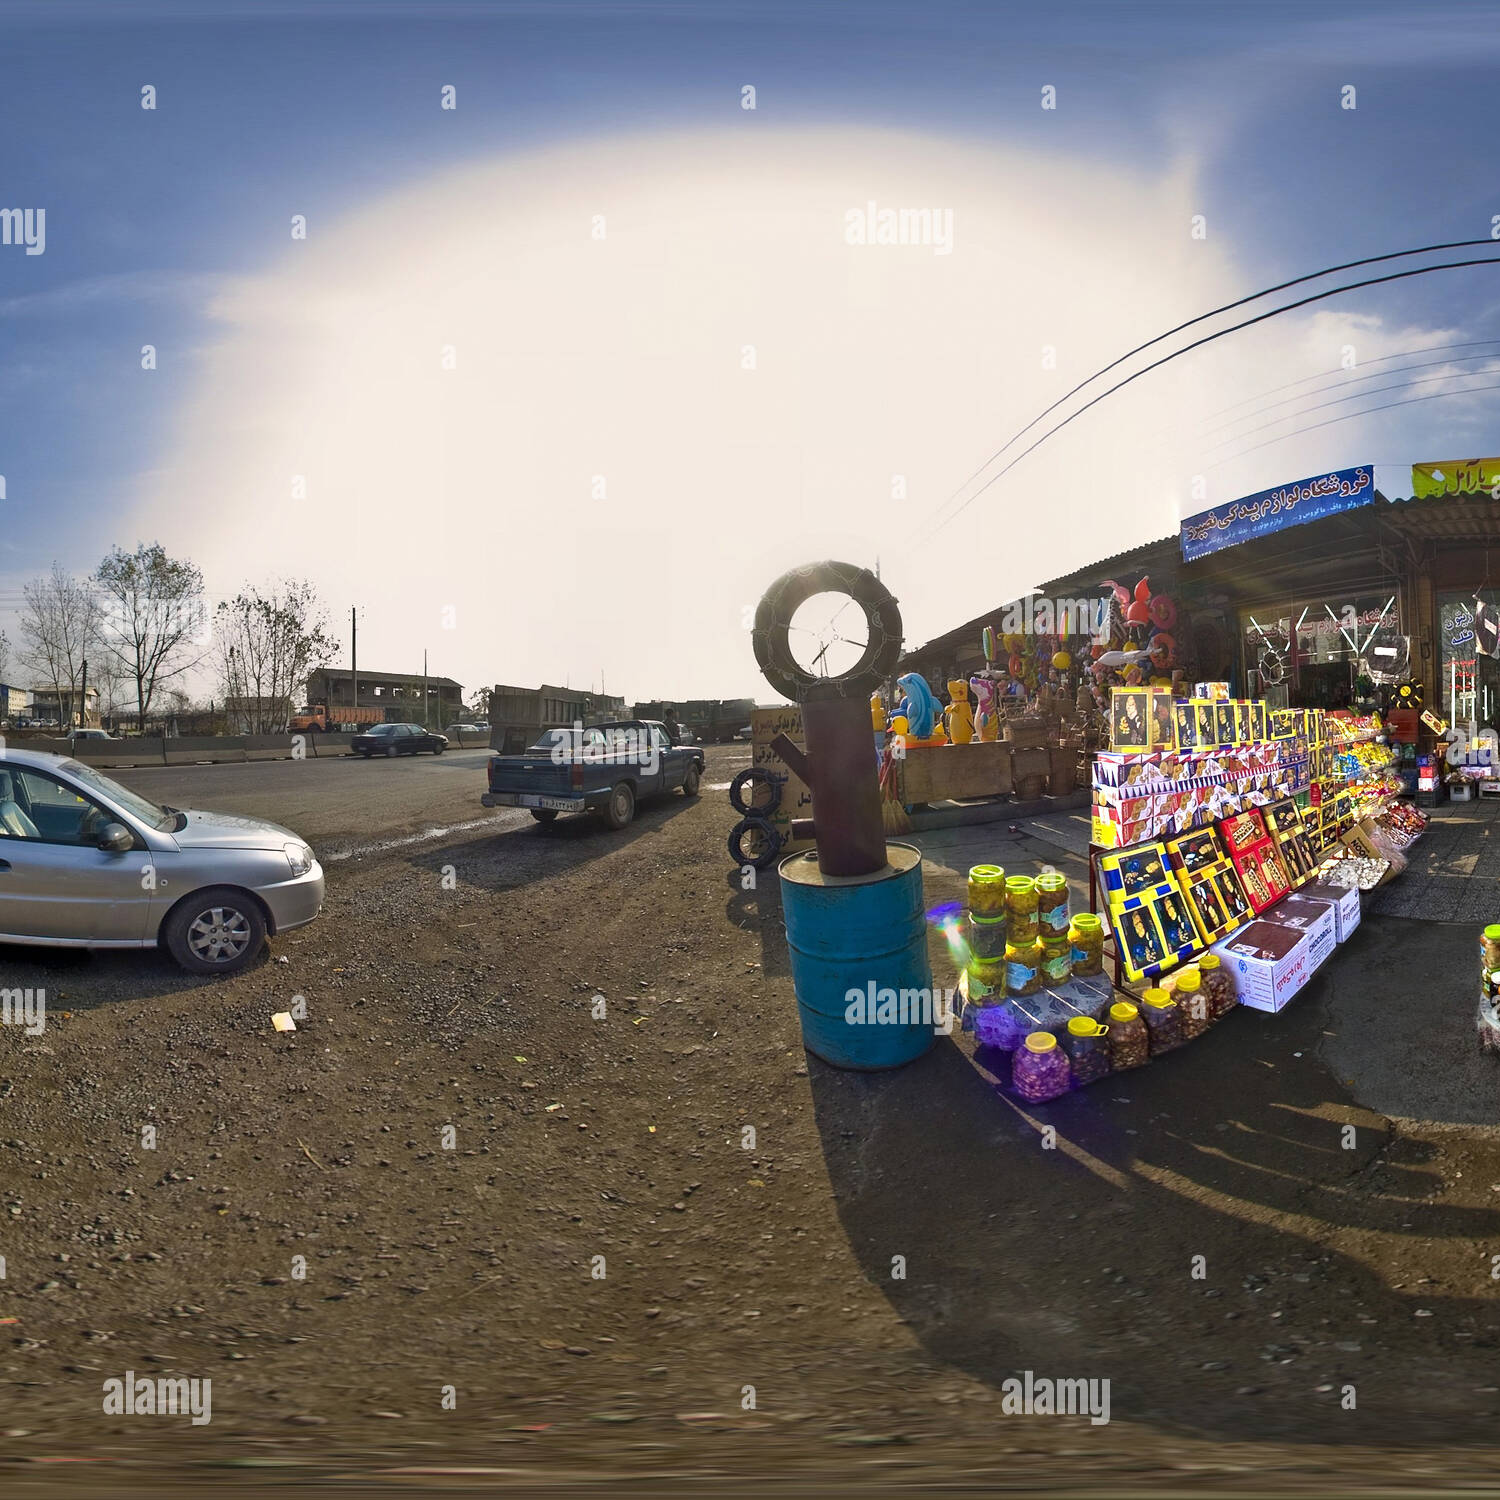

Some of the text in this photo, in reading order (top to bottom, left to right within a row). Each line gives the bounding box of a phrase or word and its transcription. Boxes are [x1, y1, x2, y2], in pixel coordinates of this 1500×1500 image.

[1302, 468, 1371, 499] فروشگاه
[1216, 501, 1261, 529] یدکی
[1260, 486, 1301, 519] لوازم
[1357, 605, 1400, 630] فروشگاه
[1444, 610, 1474, 631] زیتون
